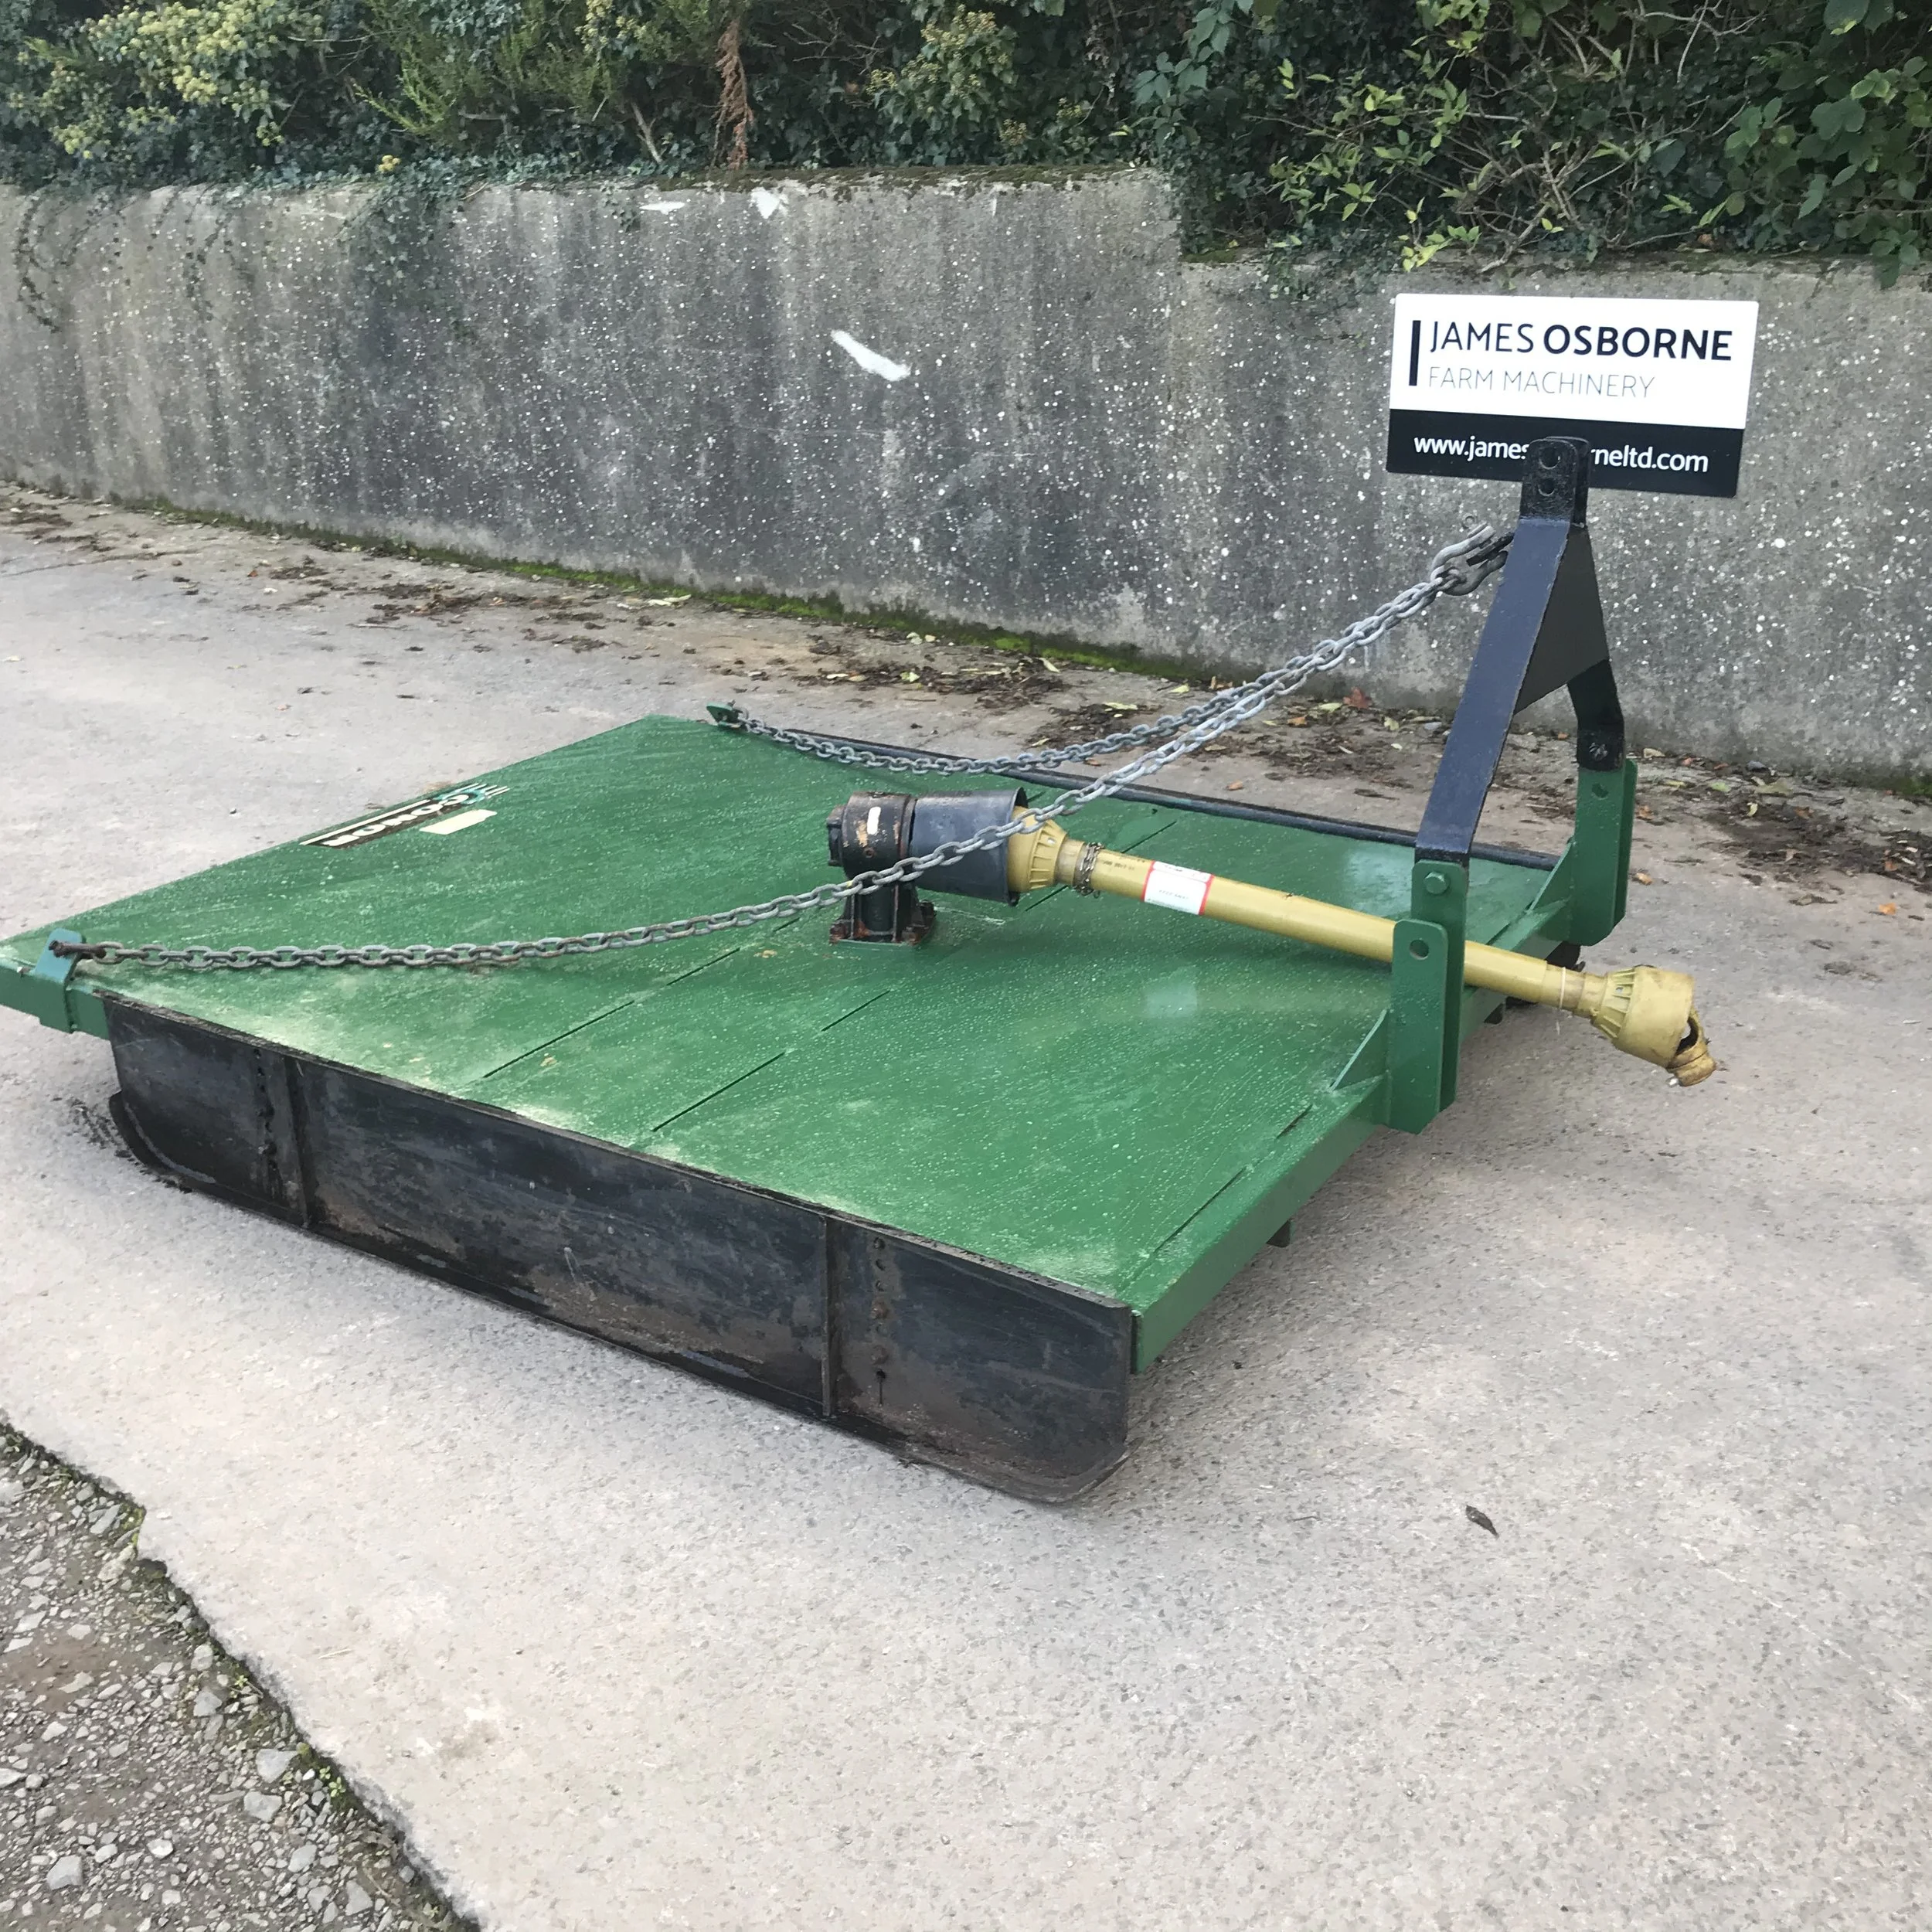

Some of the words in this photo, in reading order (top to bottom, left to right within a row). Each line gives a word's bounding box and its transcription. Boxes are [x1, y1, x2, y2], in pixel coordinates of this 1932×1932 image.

[1430, 321, 1534, 353] JAMES
[1543, 324, 1733, 361] OSBORNE
[1429, 366, 1493, 390] FARM
[1503, 370, 1655, 398] MACHINERY
